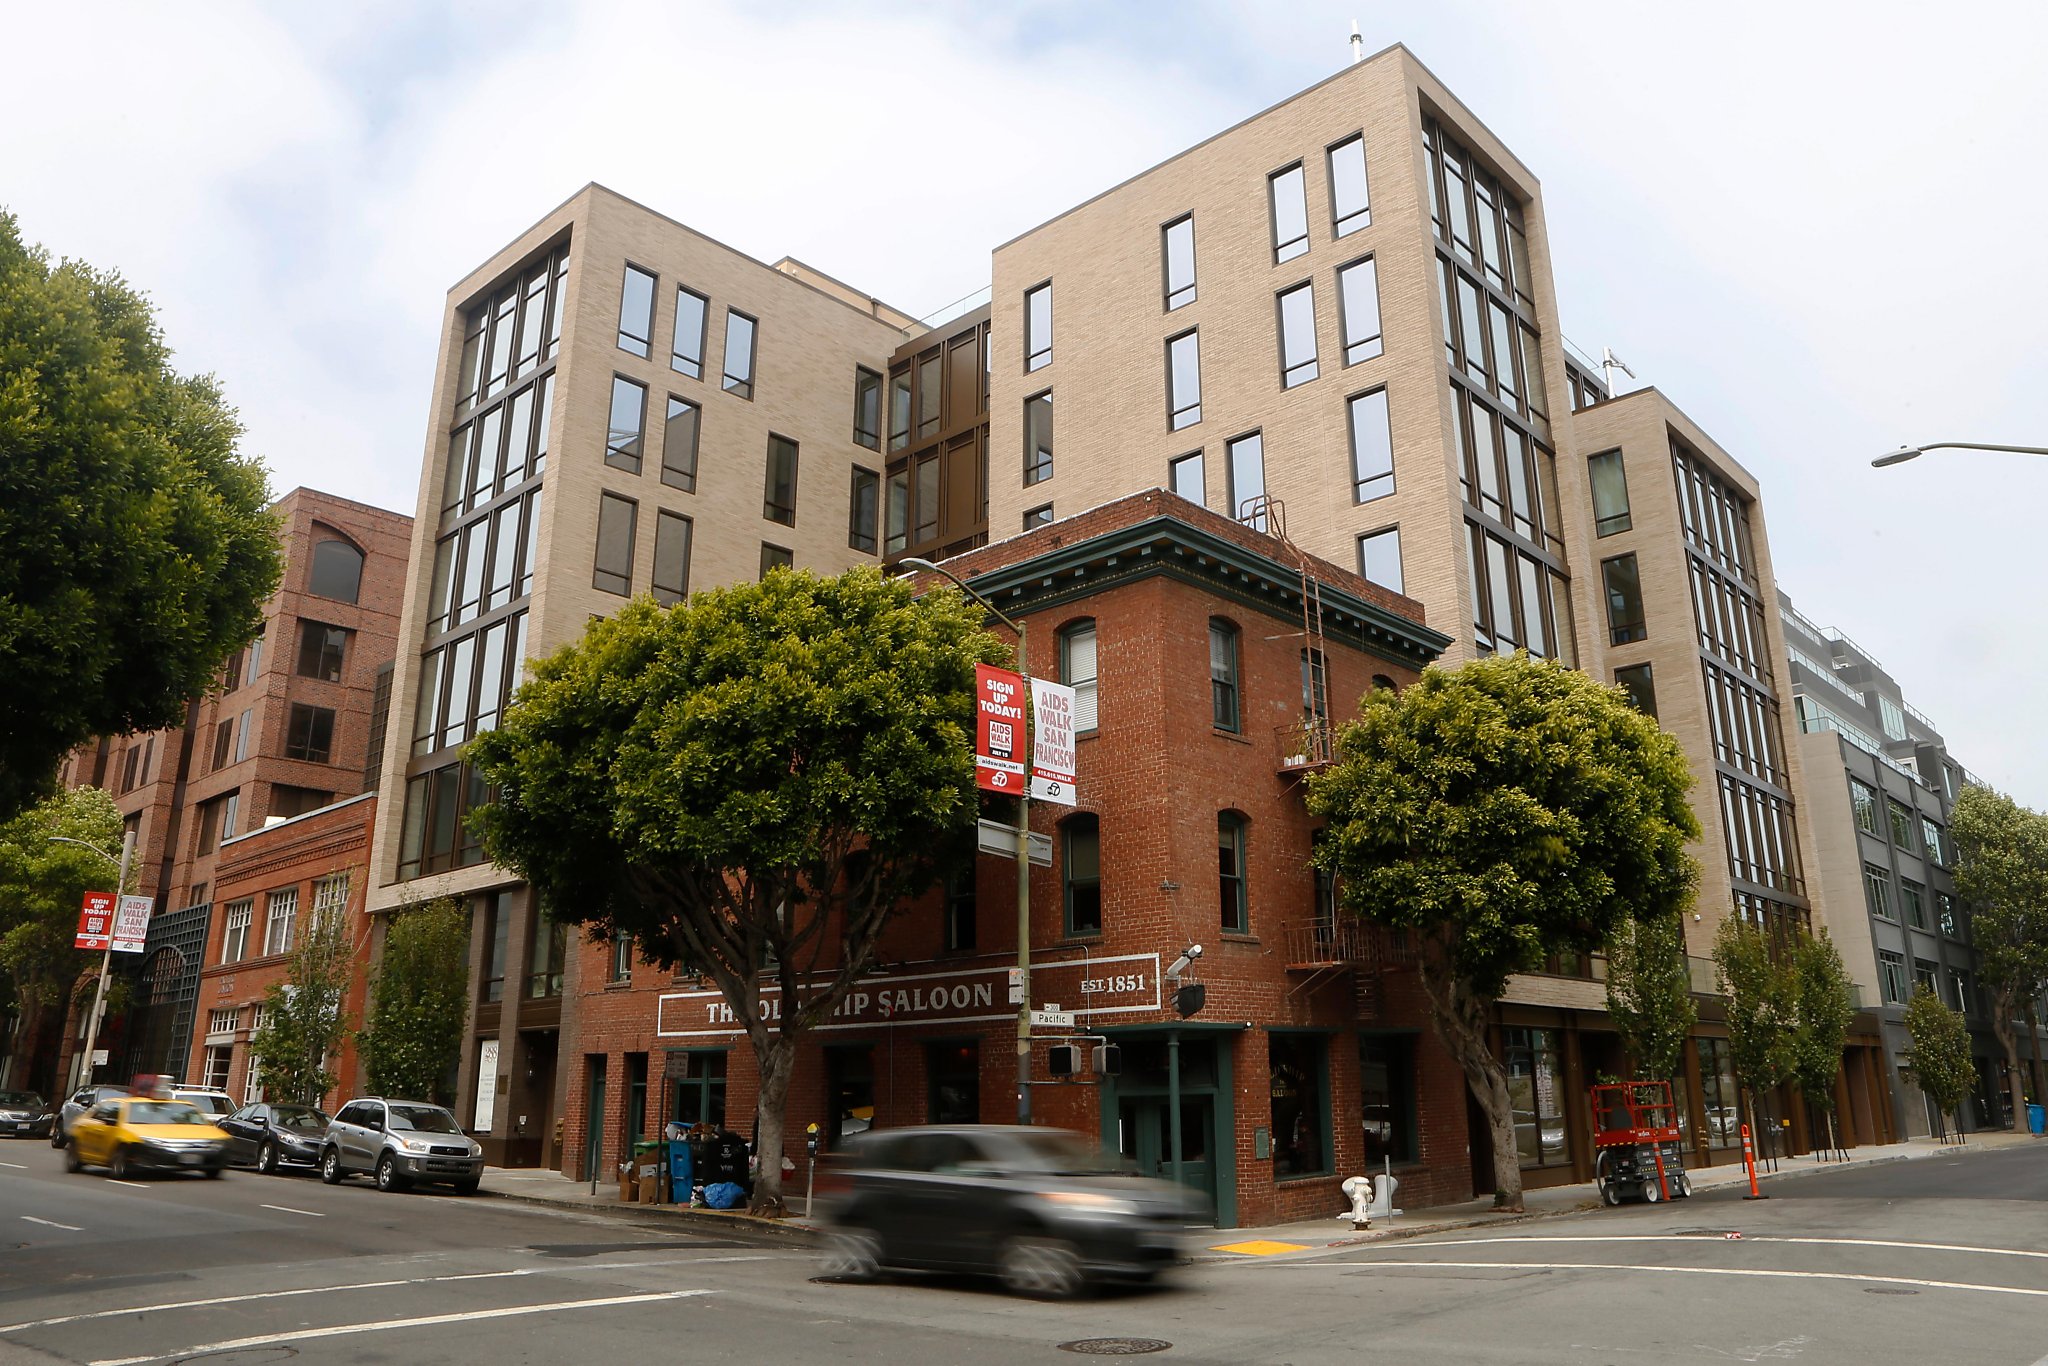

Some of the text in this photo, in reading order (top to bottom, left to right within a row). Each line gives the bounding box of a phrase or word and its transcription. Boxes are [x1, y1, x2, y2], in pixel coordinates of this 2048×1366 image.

[986, 679, 1014, 695] SIGN
[993, 692, 1008, 704] UP
[1041, 691, 1069, 712] AIDS
[980, 699, 1022, 719] TODAY!
[1039, 707, 1072, 731] WALK
[991, 723, 1011, 735] AIDS
[991, 732, 1010, 744] WALK
[1044, 727, 1067, 748] SAN
[981, 758, 1018, 770] aidswalk.net
[126, 901, 147, 910] AIDS
[84, 908, 111, 916] TODAY!
[123, 909, 148, 918] WALK
[124, 917, 143, 926] SAN
[1106, 974, 1145, 993] 1851
[706, 1001, 740, 1023] TH
[878, 983, 993, 1014] SALOON
[1038, 1014, 1066, 1023] Pacific
